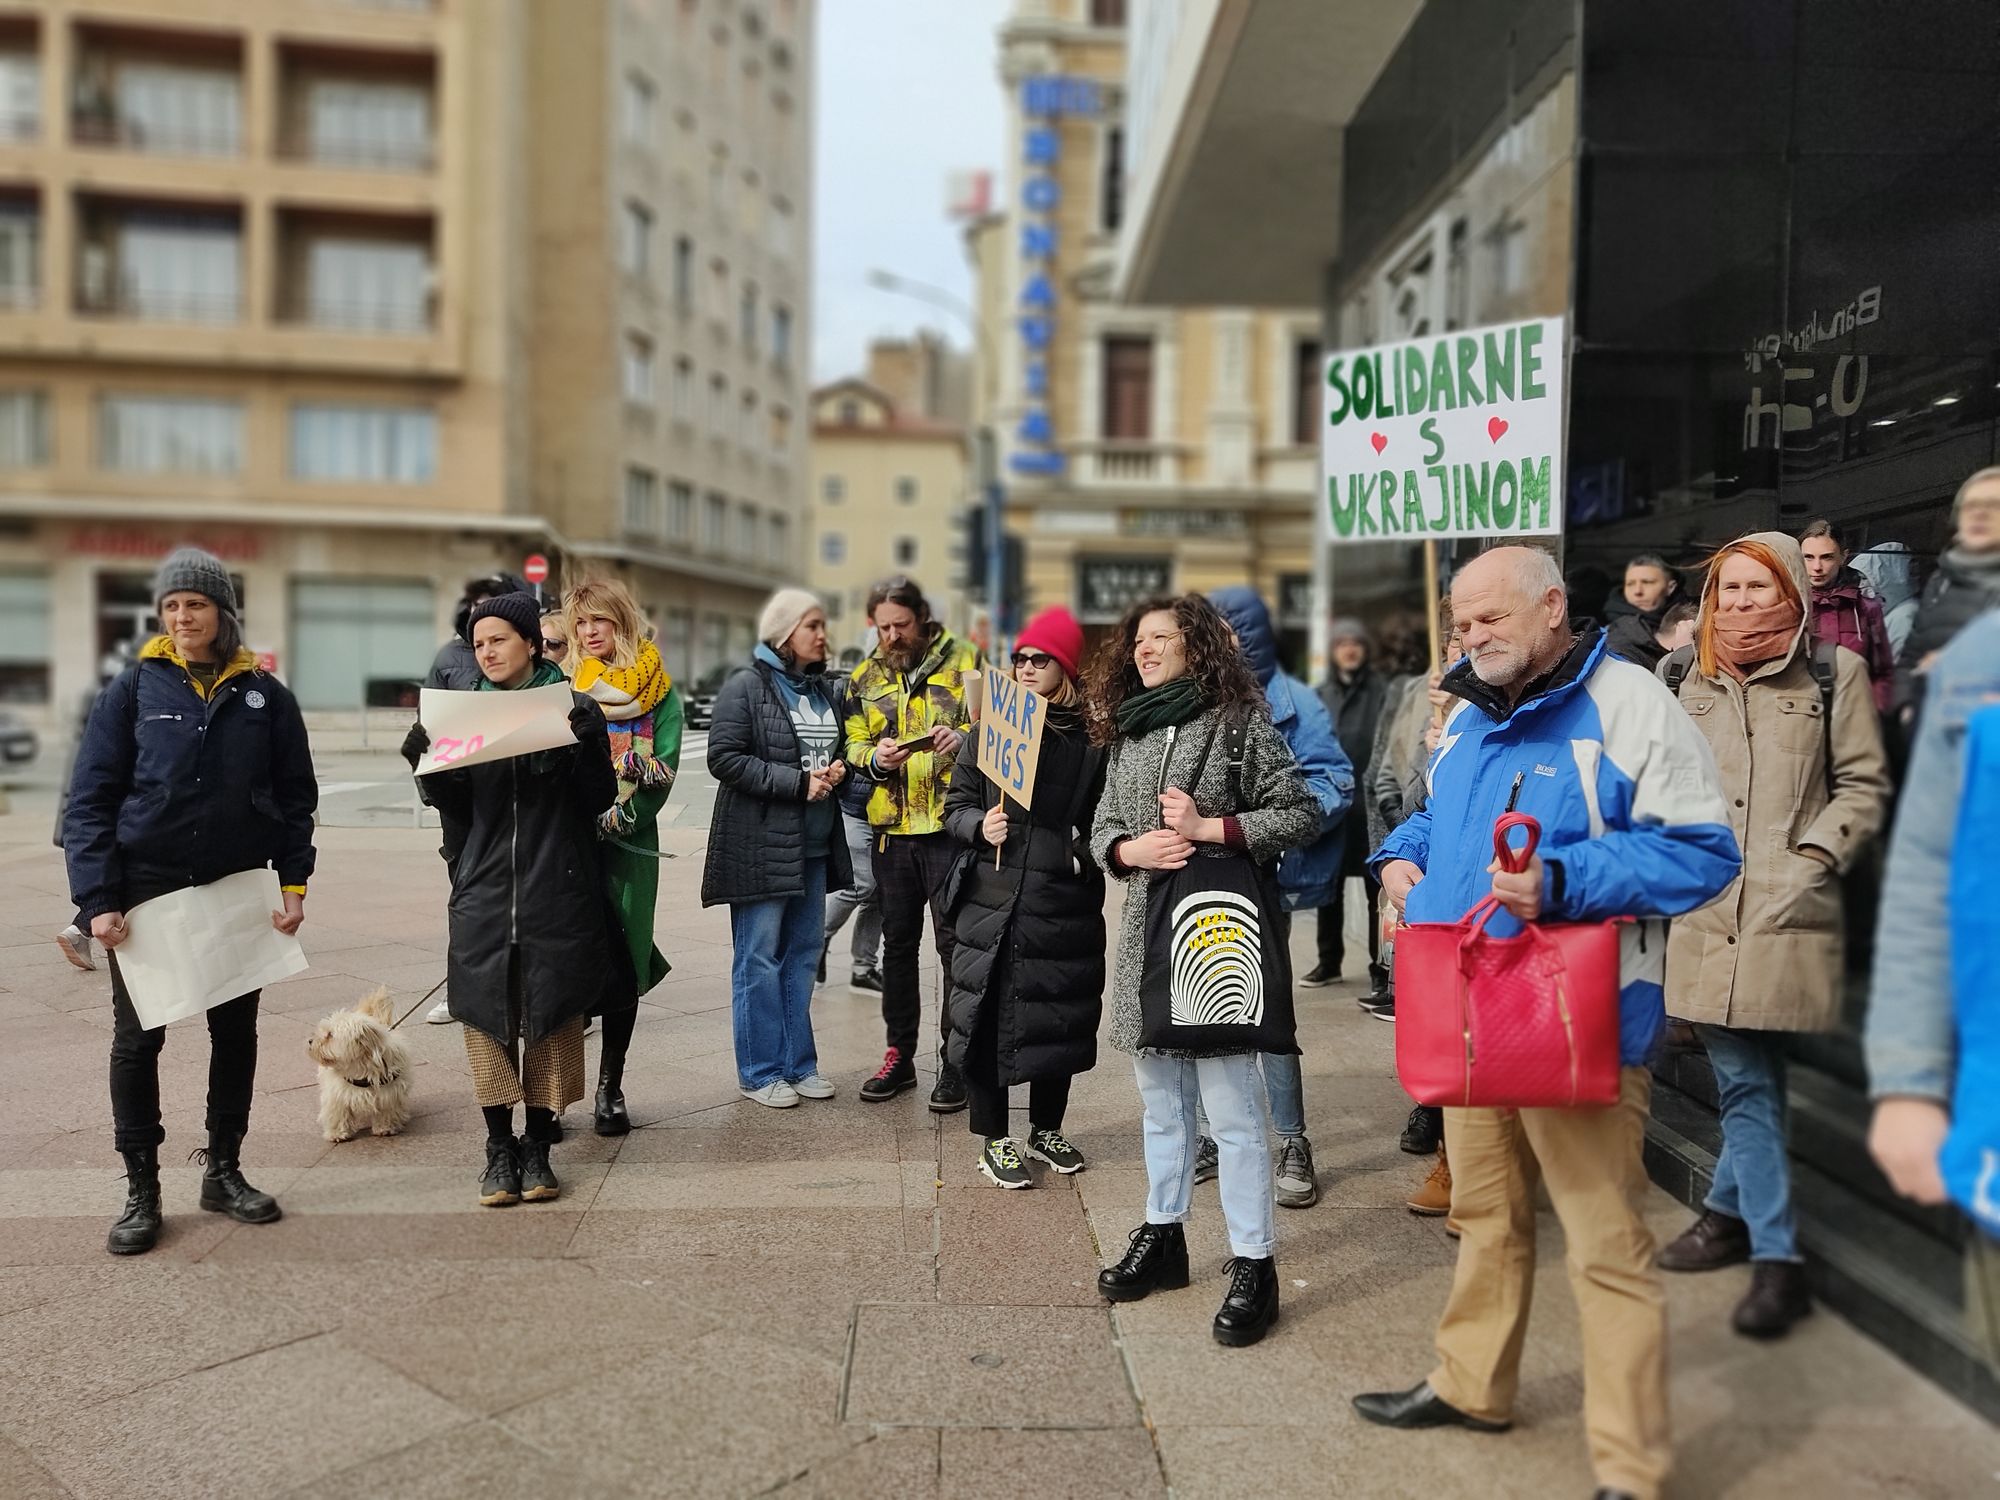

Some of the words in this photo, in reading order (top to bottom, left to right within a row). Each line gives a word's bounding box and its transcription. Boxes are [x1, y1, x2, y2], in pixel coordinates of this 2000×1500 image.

[1328, 323, 1546, 426] SOLIDARNE
[1419, 417, 1445, 465] S
[1328, 455, 1551, 537] UKRAJINOM
[989, 670, 1037, 740] WAR
[985, 724, 1027, 791] PIGS
